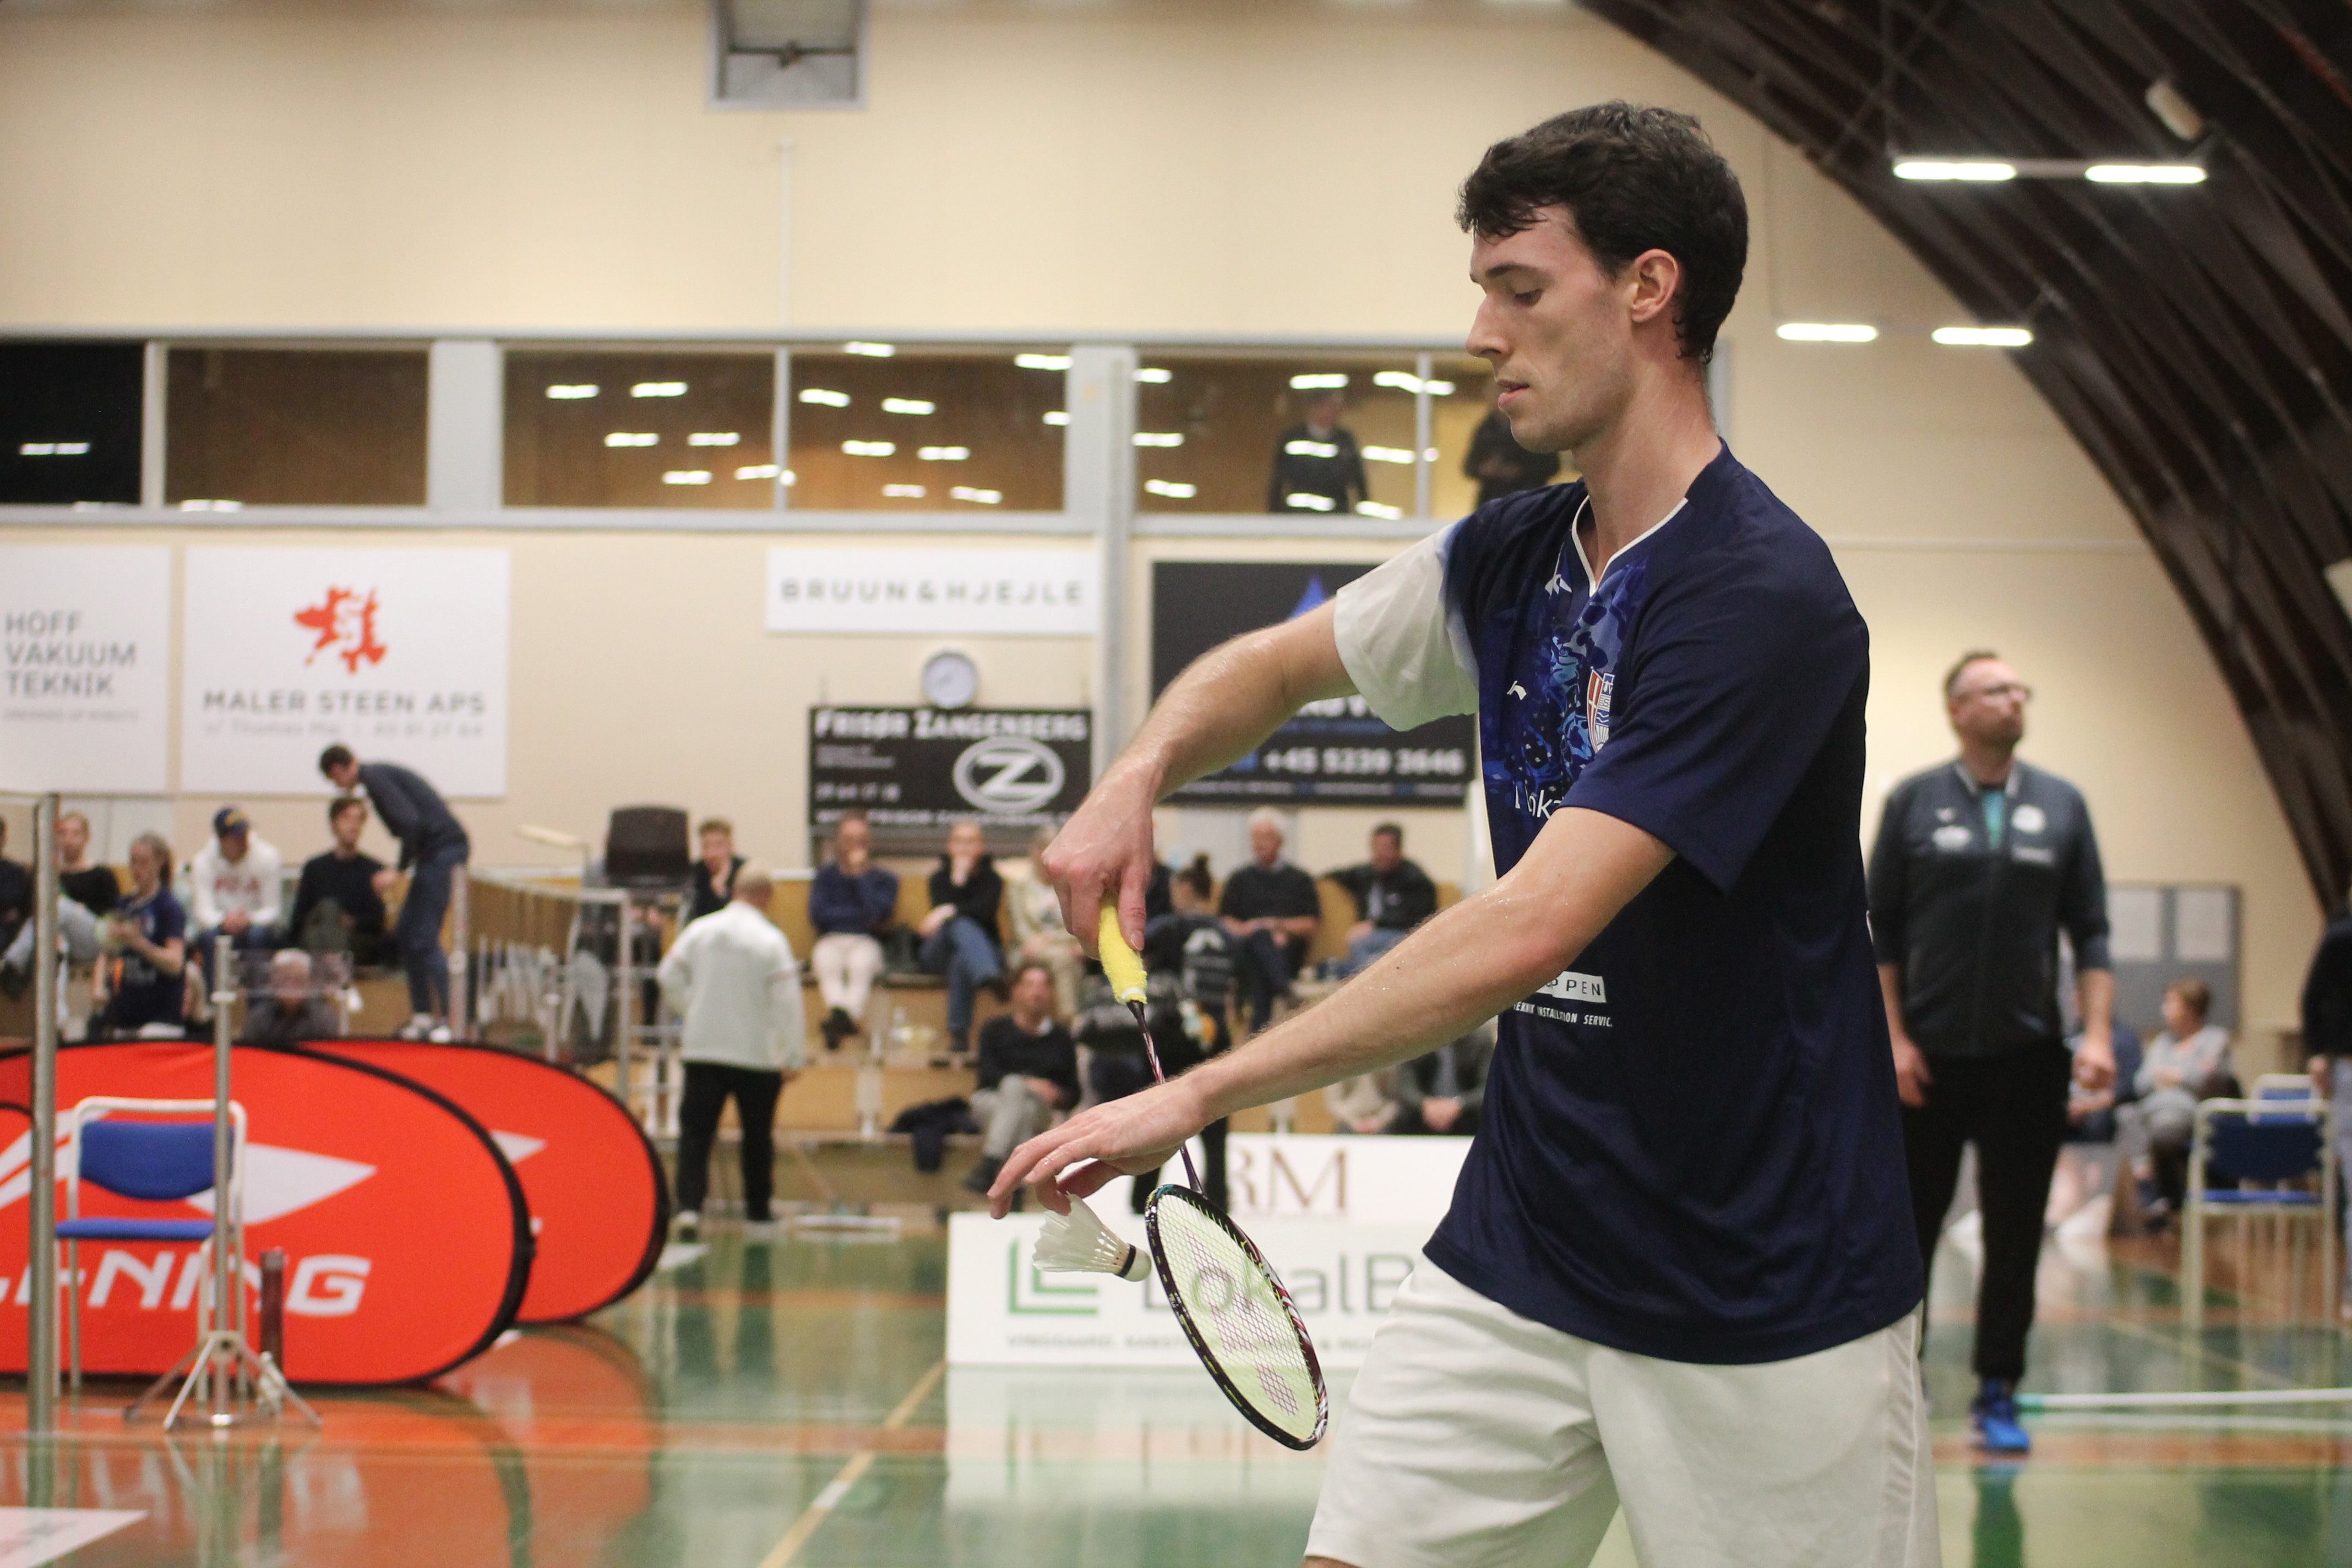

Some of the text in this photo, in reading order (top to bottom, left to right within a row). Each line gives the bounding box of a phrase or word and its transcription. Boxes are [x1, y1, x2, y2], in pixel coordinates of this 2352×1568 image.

[5, 609, 83, 636] HOFF
[5, 641, 136, 667] VAKUUM
[7, 669, 112, 697] TEKNIK
[203, 689, 485, 714] MALER STEEN APS
[1264, 747, 1319, 775] +45
[1583, 1014, 1613, 1027] SERVIC
